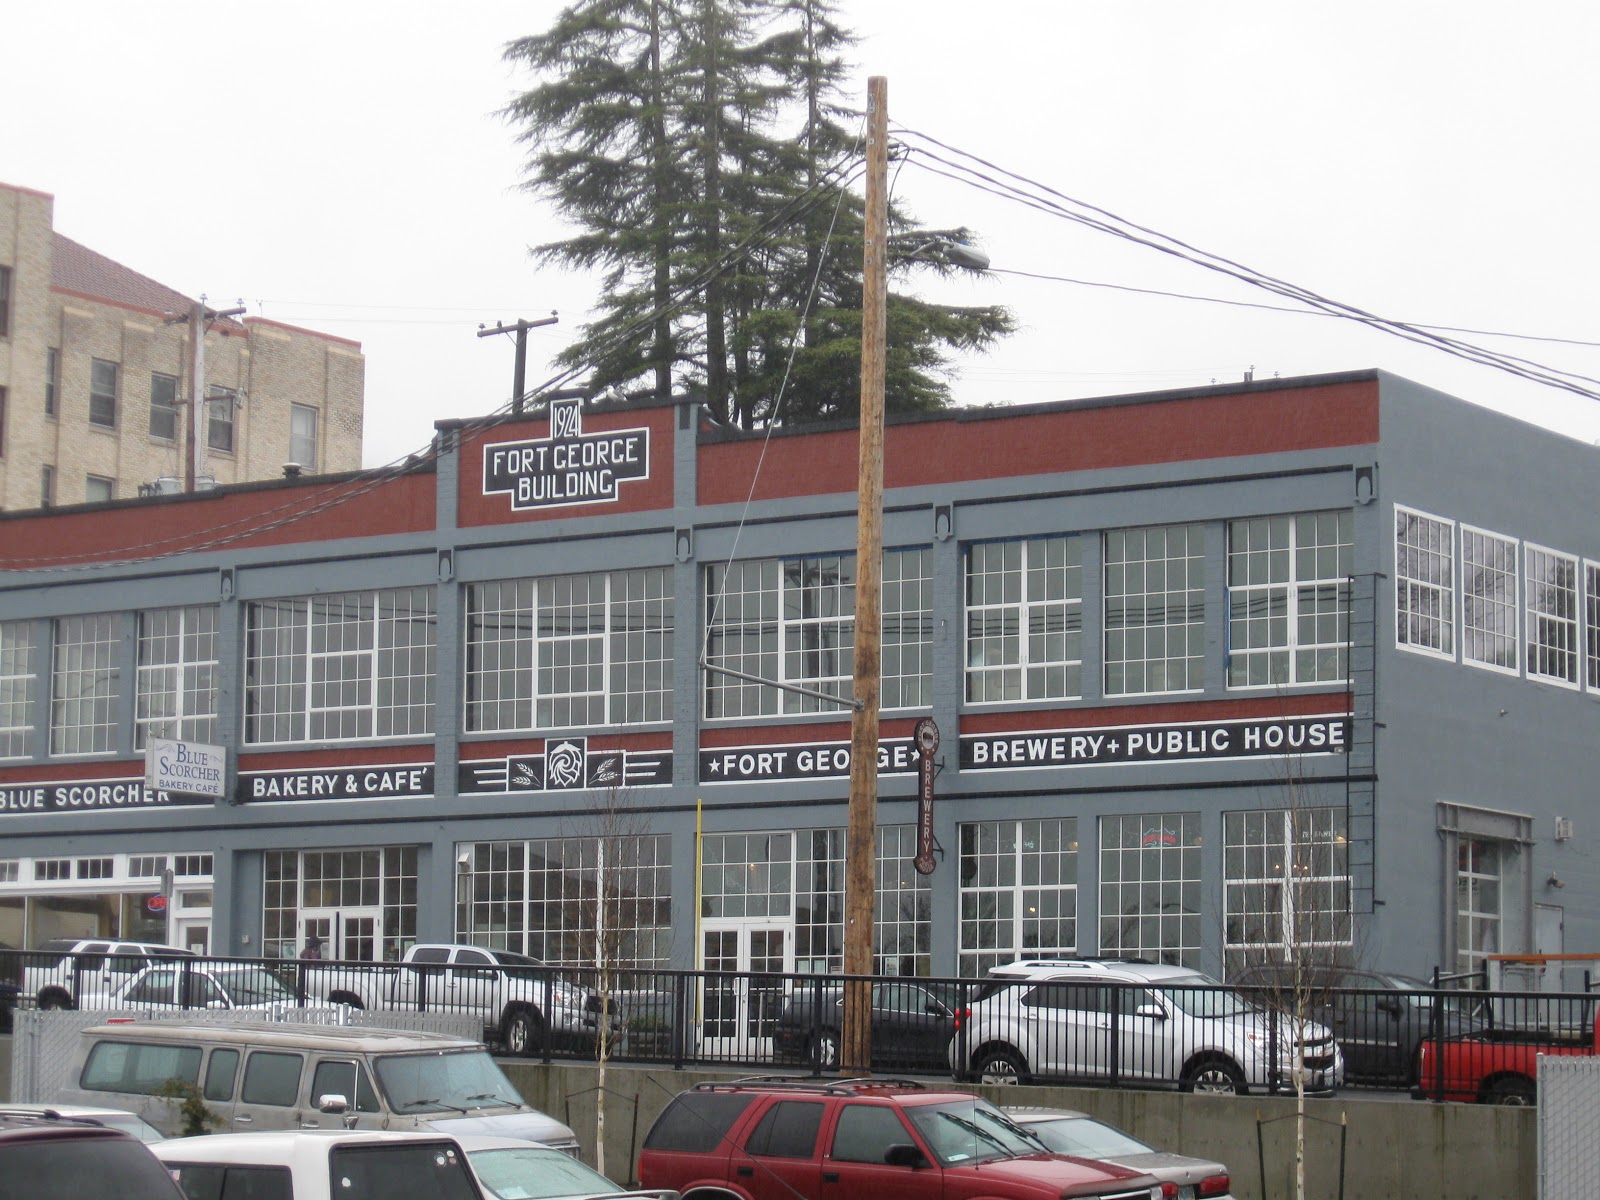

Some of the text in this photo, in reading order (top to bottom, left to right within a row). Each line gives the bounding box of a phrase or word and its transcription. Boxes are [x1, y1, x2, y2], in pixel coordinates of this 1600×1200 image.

[553, 405, 579, 438] 1924
[493, 437, 638, 476] FORT GEORGE
[518, 469, 613, 501] BUILDING
[176, 743, 208, 766] BLUE
[972, 736, 1104, 764] BREWERY
[1127, 729, 1230, 756] PUBLIC
[1244, 722, 1344, 750] HOUSE
[159, 756, 221, 782] SCORCHER
[723, 745, 908, 776] FORT GEOGE
[158, 779, 194, 792] BAKERY
[253, 775, 338, 797] BAKERY
[345, 774, 358, 793] &
[0, 789, 45, 809] BLUE
[147, 897, 169, 909] OPE
